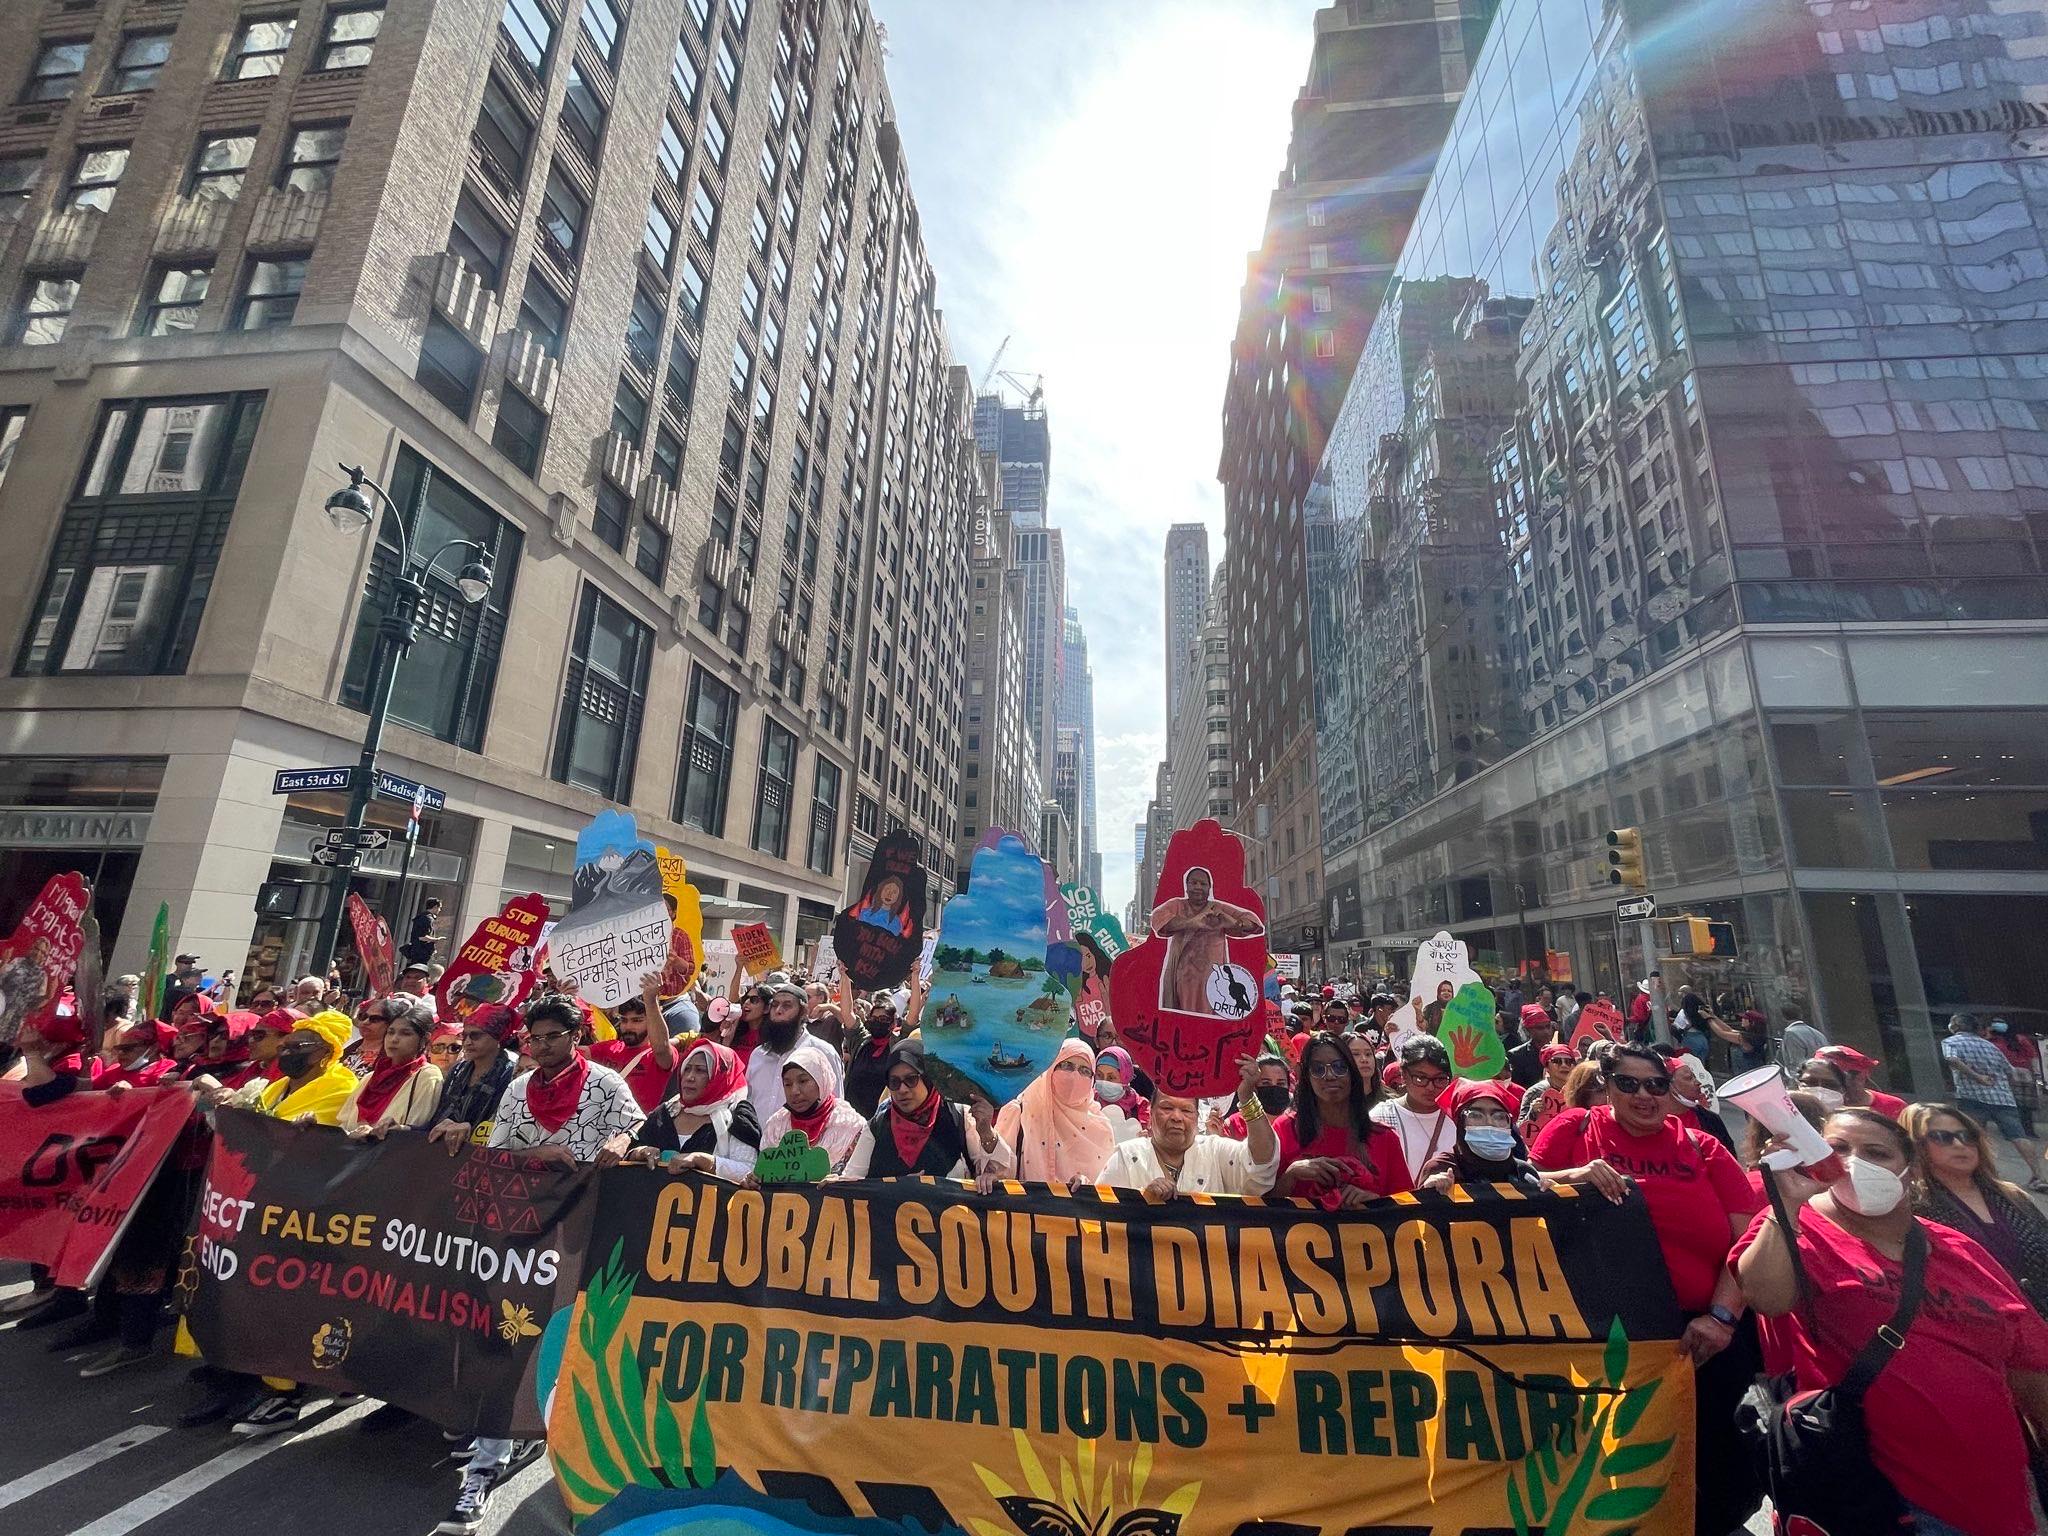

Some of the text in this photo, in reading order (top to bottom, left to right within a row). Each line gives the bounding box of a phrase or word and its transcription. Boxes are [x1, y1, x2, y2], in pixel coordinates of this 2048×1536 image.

[974, 504, 986, 546] 485
[280, 773, 345, 788] East 53rd St
[380, 778, 442, 808] Madiso Ave
[0, 816, 134, 839] ARMINA
[332, 832, 380, 845] ON WAY
[319, 851, 335, 862] ONE
[506, 908, 538, 926] STOP
[1067, 903, 1096, 921] ORE
[1620, 901, 1651, 917] ONE WAY
[485, 921, 530, 945] BURNING
[737, 928, 765, 942] BIDEN
[485, 939, 508, 954] OUR
[743, 943, 771, 957] CLIMATE
[461, 945, 509, 973] FUTURE
[1080, 999, 1104, 1016] END
[1213, 1001, 1245, 1018] DRUM
[784, 1133, 804, 1146] WE
[763, 1147, 805, 1160] WANT
[784, 1161, 800, 1170] TO
[202, 1180, 561, 1287] JECT FALSE SOLUTIONS
[646, 1182, 1592, 1340] GLOBAL SOUTH DIASPORA
[637, 1320, 1580, 1462] FOR REPARATIONS + REPAIR
